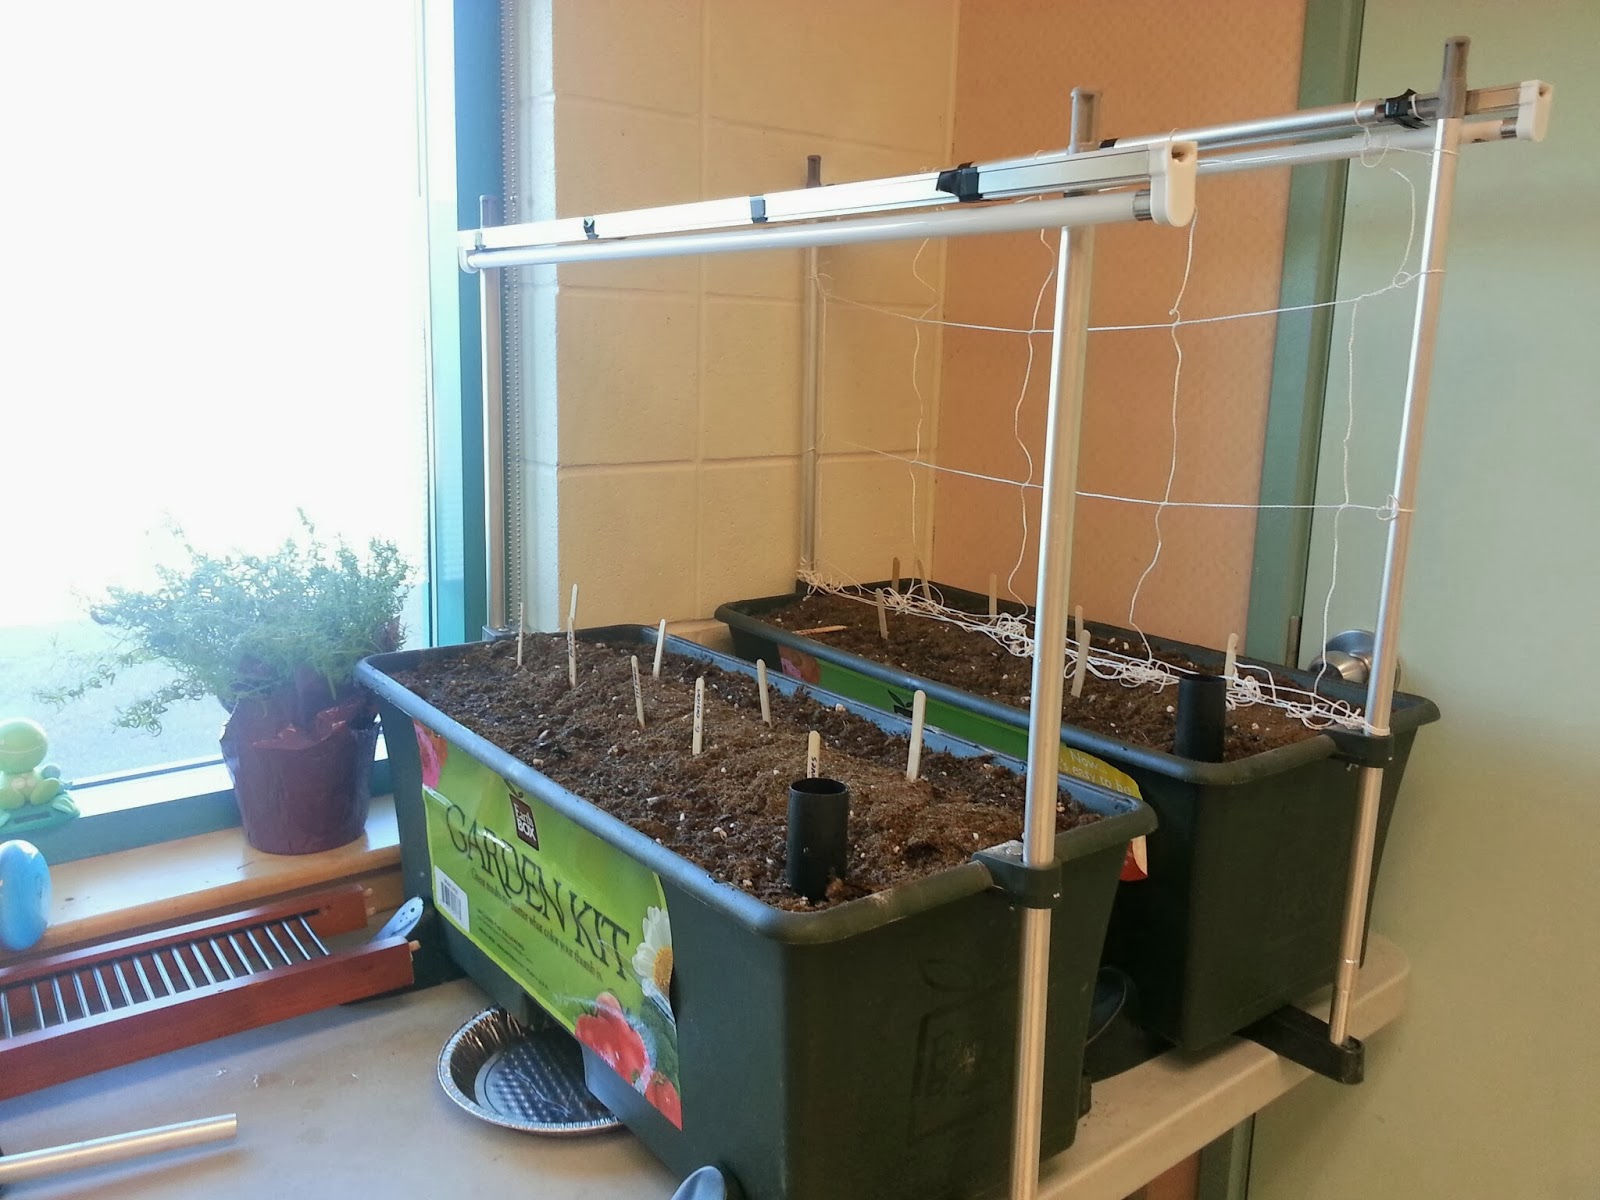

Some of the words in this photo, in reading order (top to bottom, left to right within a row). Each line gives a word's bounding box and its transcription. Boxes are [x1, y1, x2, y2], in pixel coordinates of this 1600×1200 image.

[1072, 766, 1096, 784] easy
[1100, 776, 1112, 788] to
[1115, 779, 1132, 796] be
[513, 803, 535, 828] Earth
[517, 818, 537, 842] BOX
[446, 804, 565, 932] GARDEN
[568, 890, 630, 981] KIT
